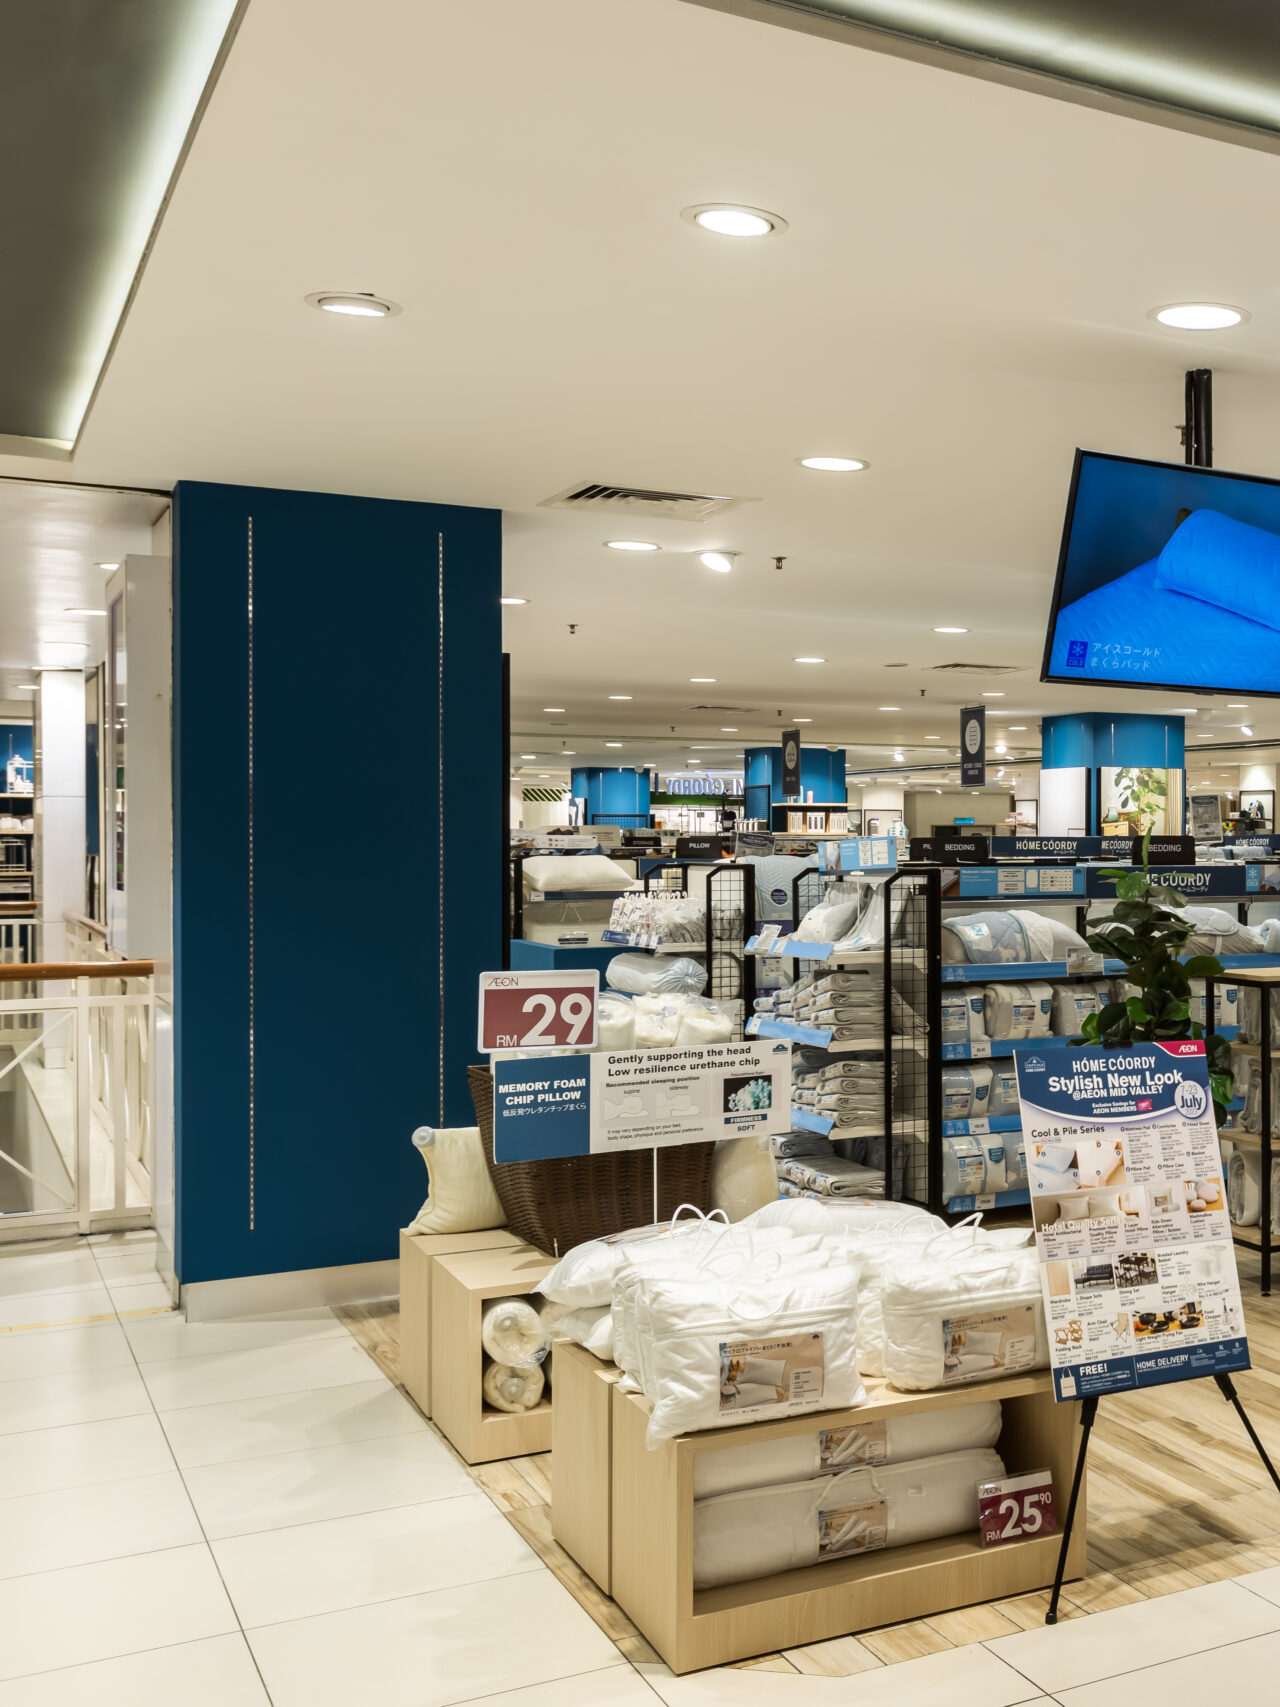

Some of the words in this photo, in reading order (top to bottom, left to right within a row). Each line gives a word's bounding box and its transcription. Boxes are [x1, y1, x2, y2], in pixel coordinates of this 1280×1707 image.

[1093, 642, 1161, 658] アイスコールド
[1016, 838, 1040, 850] HÓME
[1042, 838, 1077, 850] CÓORDY
[1149, 844, 1181, 852] BEDDING
[496, 1034, 518, 1047] RM
[519, 992, 592, 1046] 29
[608, 1054, 643, 1066] Gently
[647, 1048, 704, 1062] supporting
[706, 1048, 724, 1057] the
[726, 1046, 751, 1055] head
[608, 1068, 630, 1077] Low
[634, 1063, 686, 1074] resilience
[690, 1060, 736, 1071] urethane
[739, 1058, 760, 1069] chip
[1072, 1057, 1107, 1073] HÓME
[1108, 1056, 1156, 1071] CÓORDY
[498, 1081, 550, 1094] MEMORY
[553, 1078, 586, 1090] FOAM
[606, 1080, 649, 1088] Recommended
[651, 1078, 676, 1086] sleeping
[1048, 1074, 1103, 1095] Stylish
[1107, 1073, 1142, 1088] New
[1145, 1069, 1183, 1085] Look
[505, 1095, 534, 1106] CHIP
[537, 1091, 581, 1103] PILLOW
[1072, 1089, 1108, 1101] @AEON
[1110, 1088, 1128, 1097] MID
[1130, 1085, 1163, 1096] VALLEY
[1180, 1095, 1202, 1110] July
[737, 1124, 755, 1132] SOFT
[1031, 1129, 1051, 1139] Cool
[1053, 1128, 1060, 1136] &
[1063, 1127, 1077, 1135] Pile
[1080, 1124, 1105, 1134] Series
[1041, 1221, 1066, 1232] Hotel
[1067, 1218, 1099, 1230] Quality
[1079, 1362, 1108, 1377] FREE!
[1137, 1360, 1156, 1370] HOME
[1157, 1354, 1189, 1367] DELIVERY
[986, 1529, 1001, 1541] RM
[998, 1493, 1042, 1539] 25
